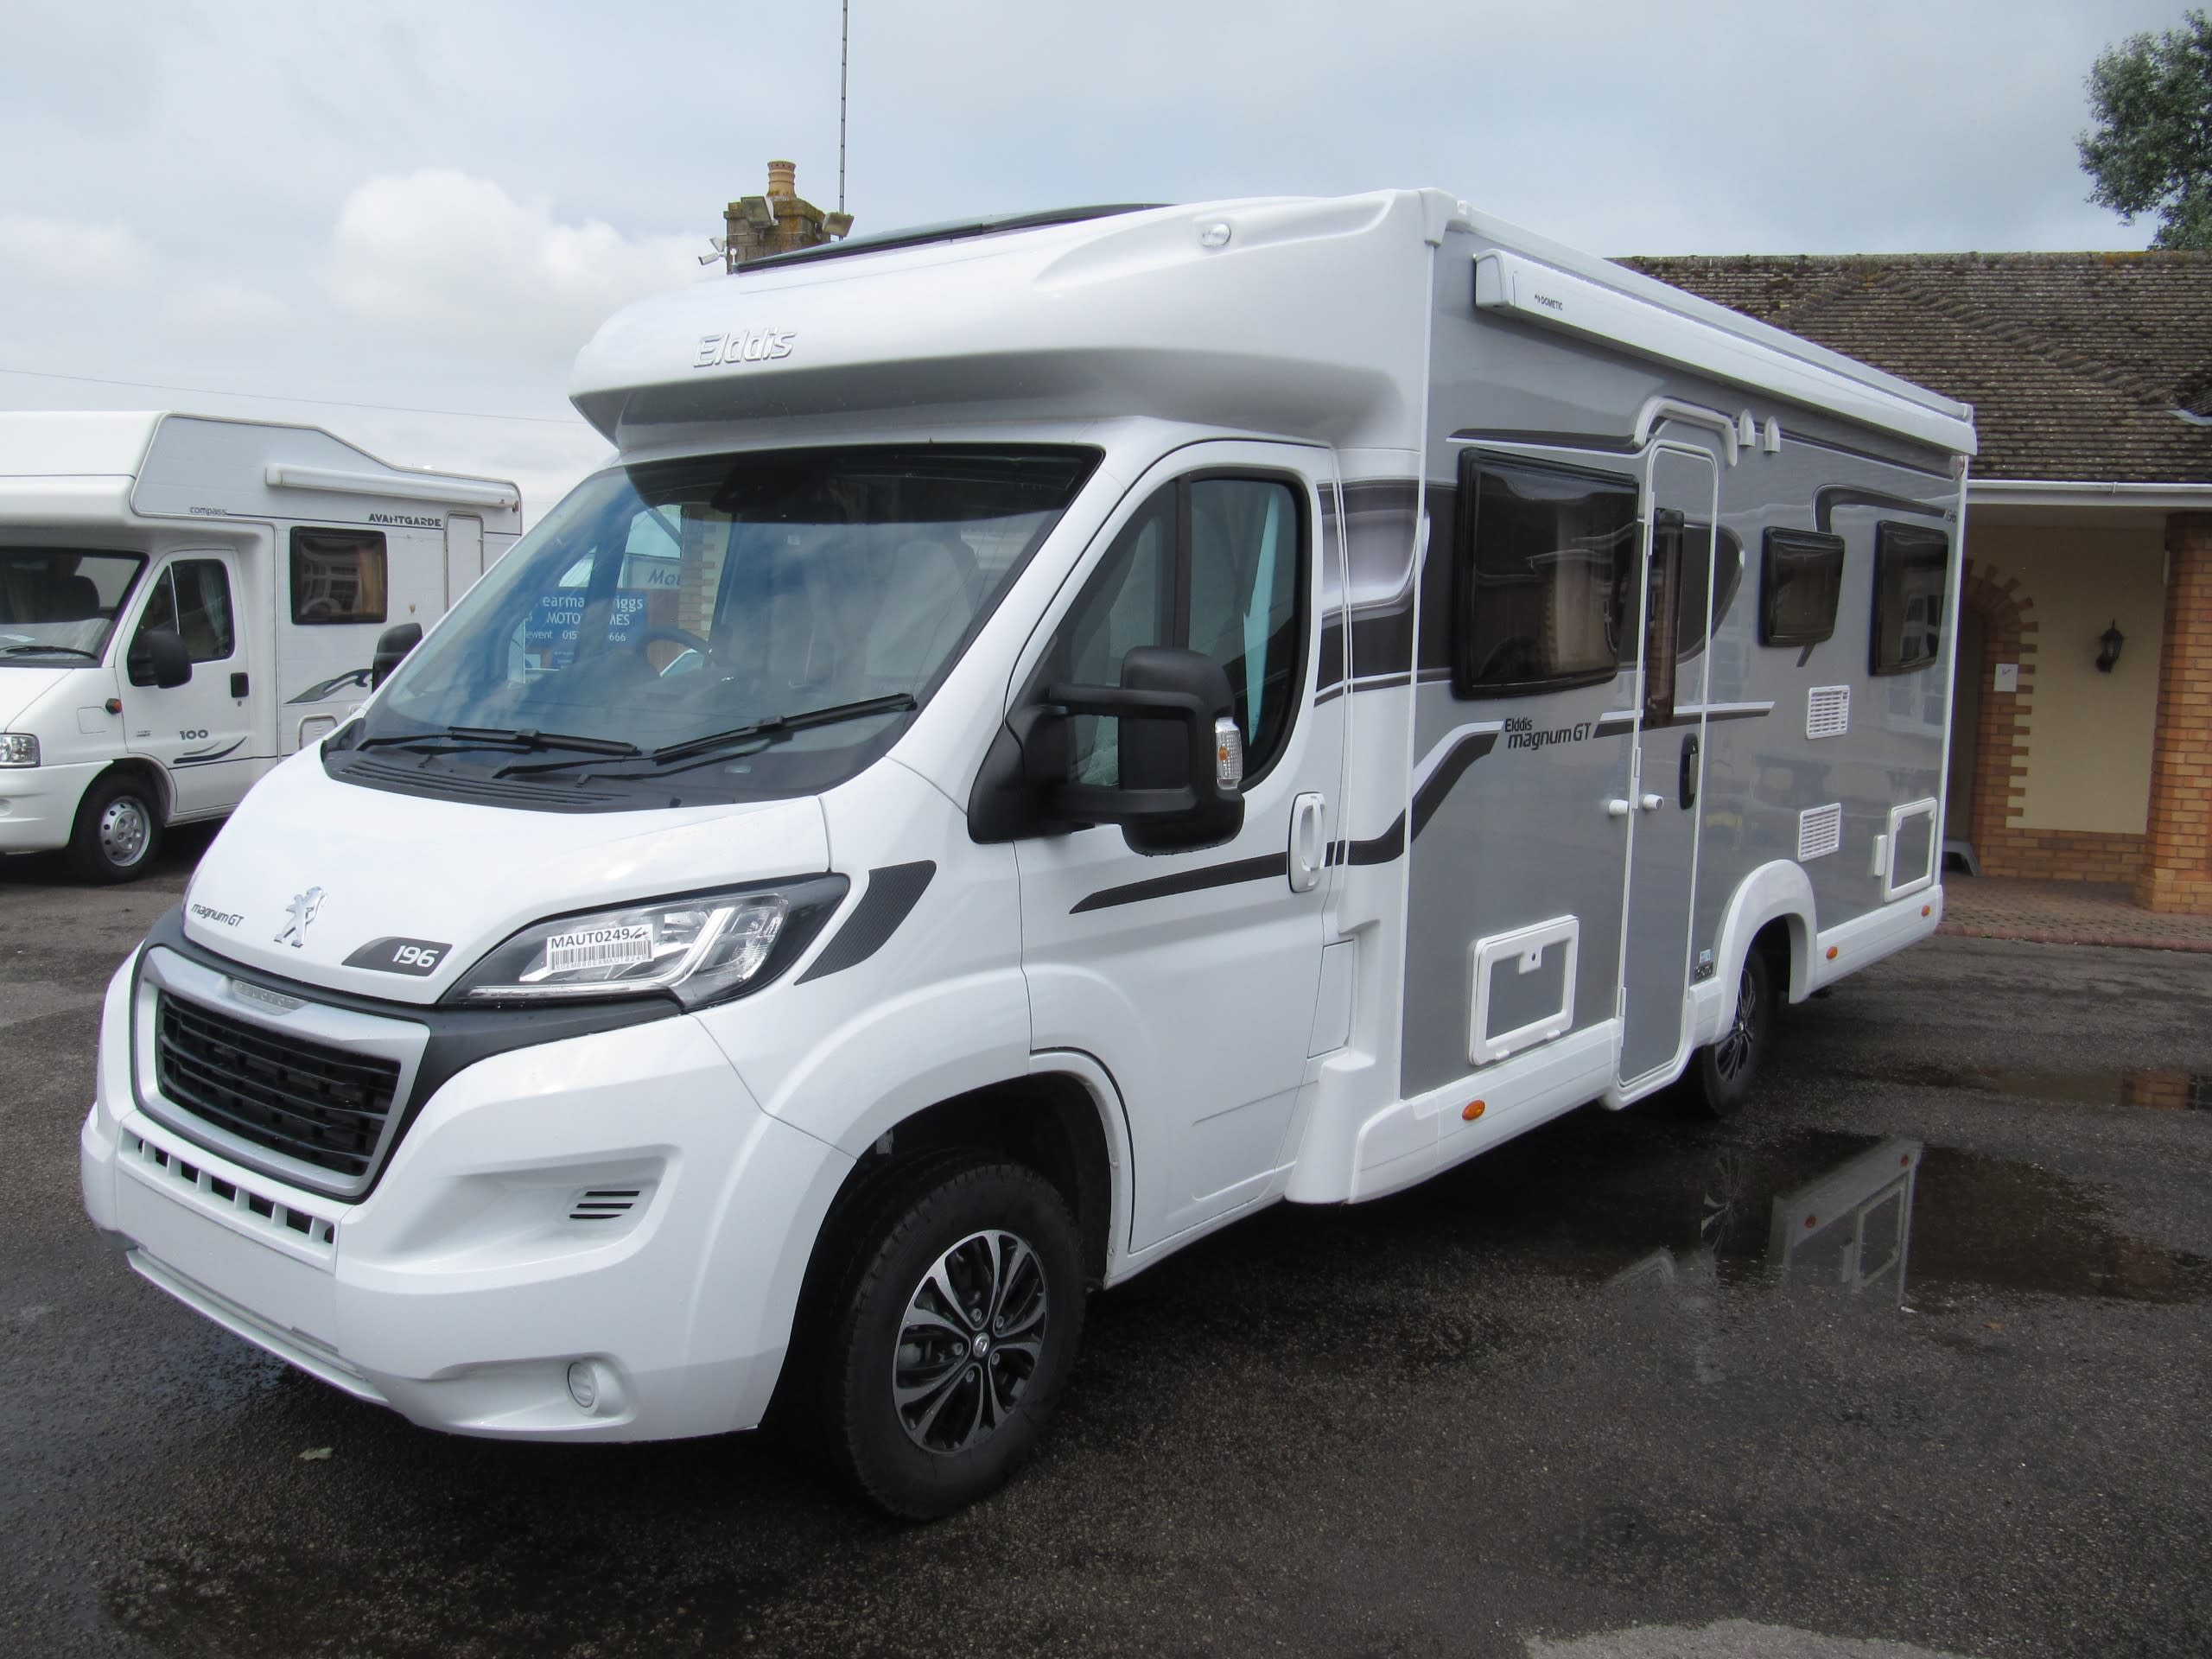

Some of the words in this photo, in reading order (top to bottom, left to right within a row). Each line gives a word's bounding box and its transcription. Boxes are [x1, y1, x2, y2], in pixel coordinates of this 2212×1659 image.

[693, 326, 796, 368] Elddis
[189, 505, 227, 517] compass
[368, 512, 442, 528] AVANTGARDE
[542, 596, 585, 608] earma
[616, 595, 644, 613] iggs
[525, 630, 553, 639] ewent
[1504, 716, 1533, 733] Elddis
[179, 729, 209, 741] 100
[551, 928, 630, 949] MAUT0249
[391, 944, 440, 968] 196
